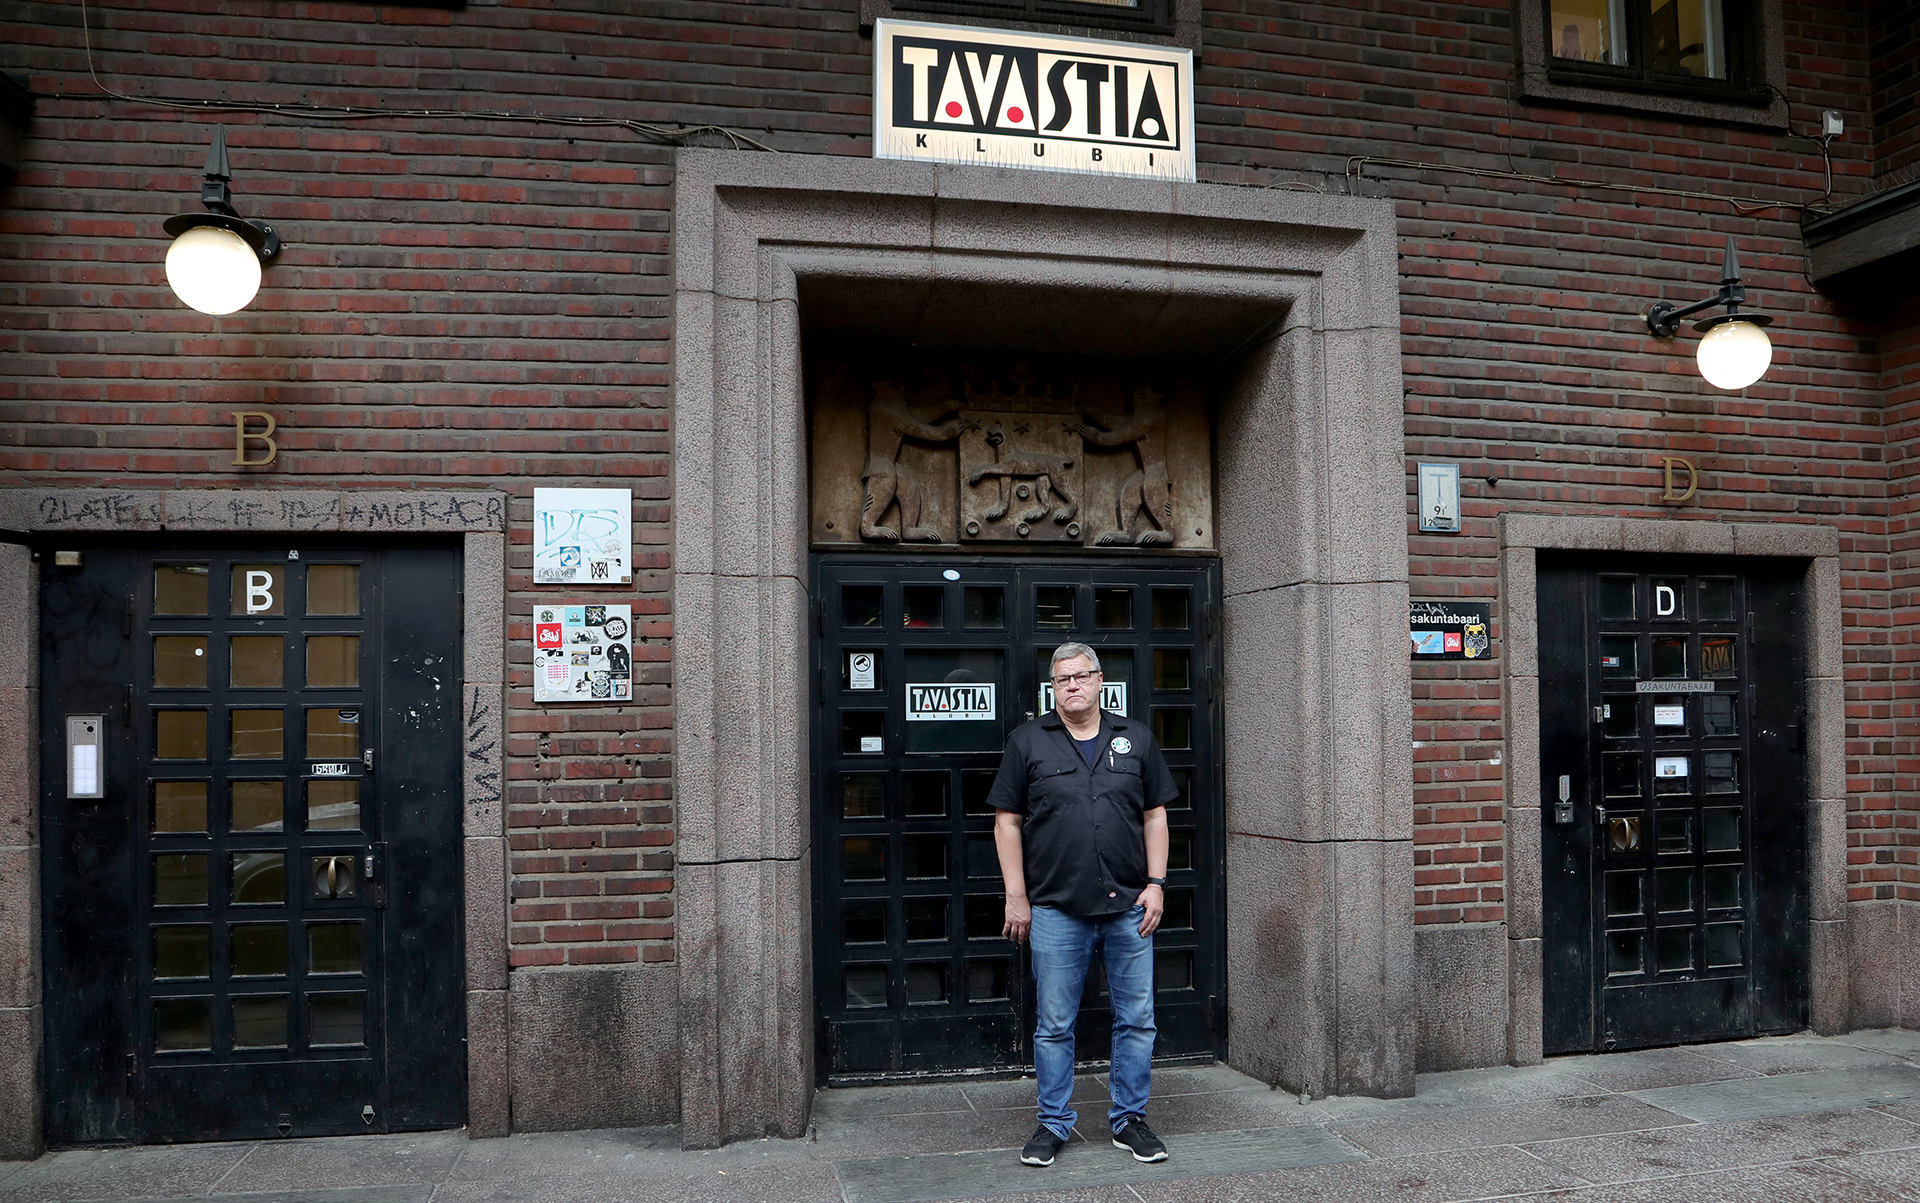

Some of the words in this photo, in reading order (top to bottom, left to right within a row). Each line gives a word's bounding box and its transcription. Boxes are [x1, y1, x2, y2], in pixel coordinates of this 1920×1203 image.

[902, 46, 1170, 142] TAVASTIA
[916, 133, 1154, 167] KLUBI
[232, 411, 277, 466] B
[1662, 456, 1698, 501] D
[246, 570, 273, 611] B
[1656, 586, 1675, 616] D
[1410, 613, 1480, 624] sakuntabaari
[912, 688, 988, 711] TAVASTIA
[1640, 682, 1712, 691] OSAKUNTABAARI
